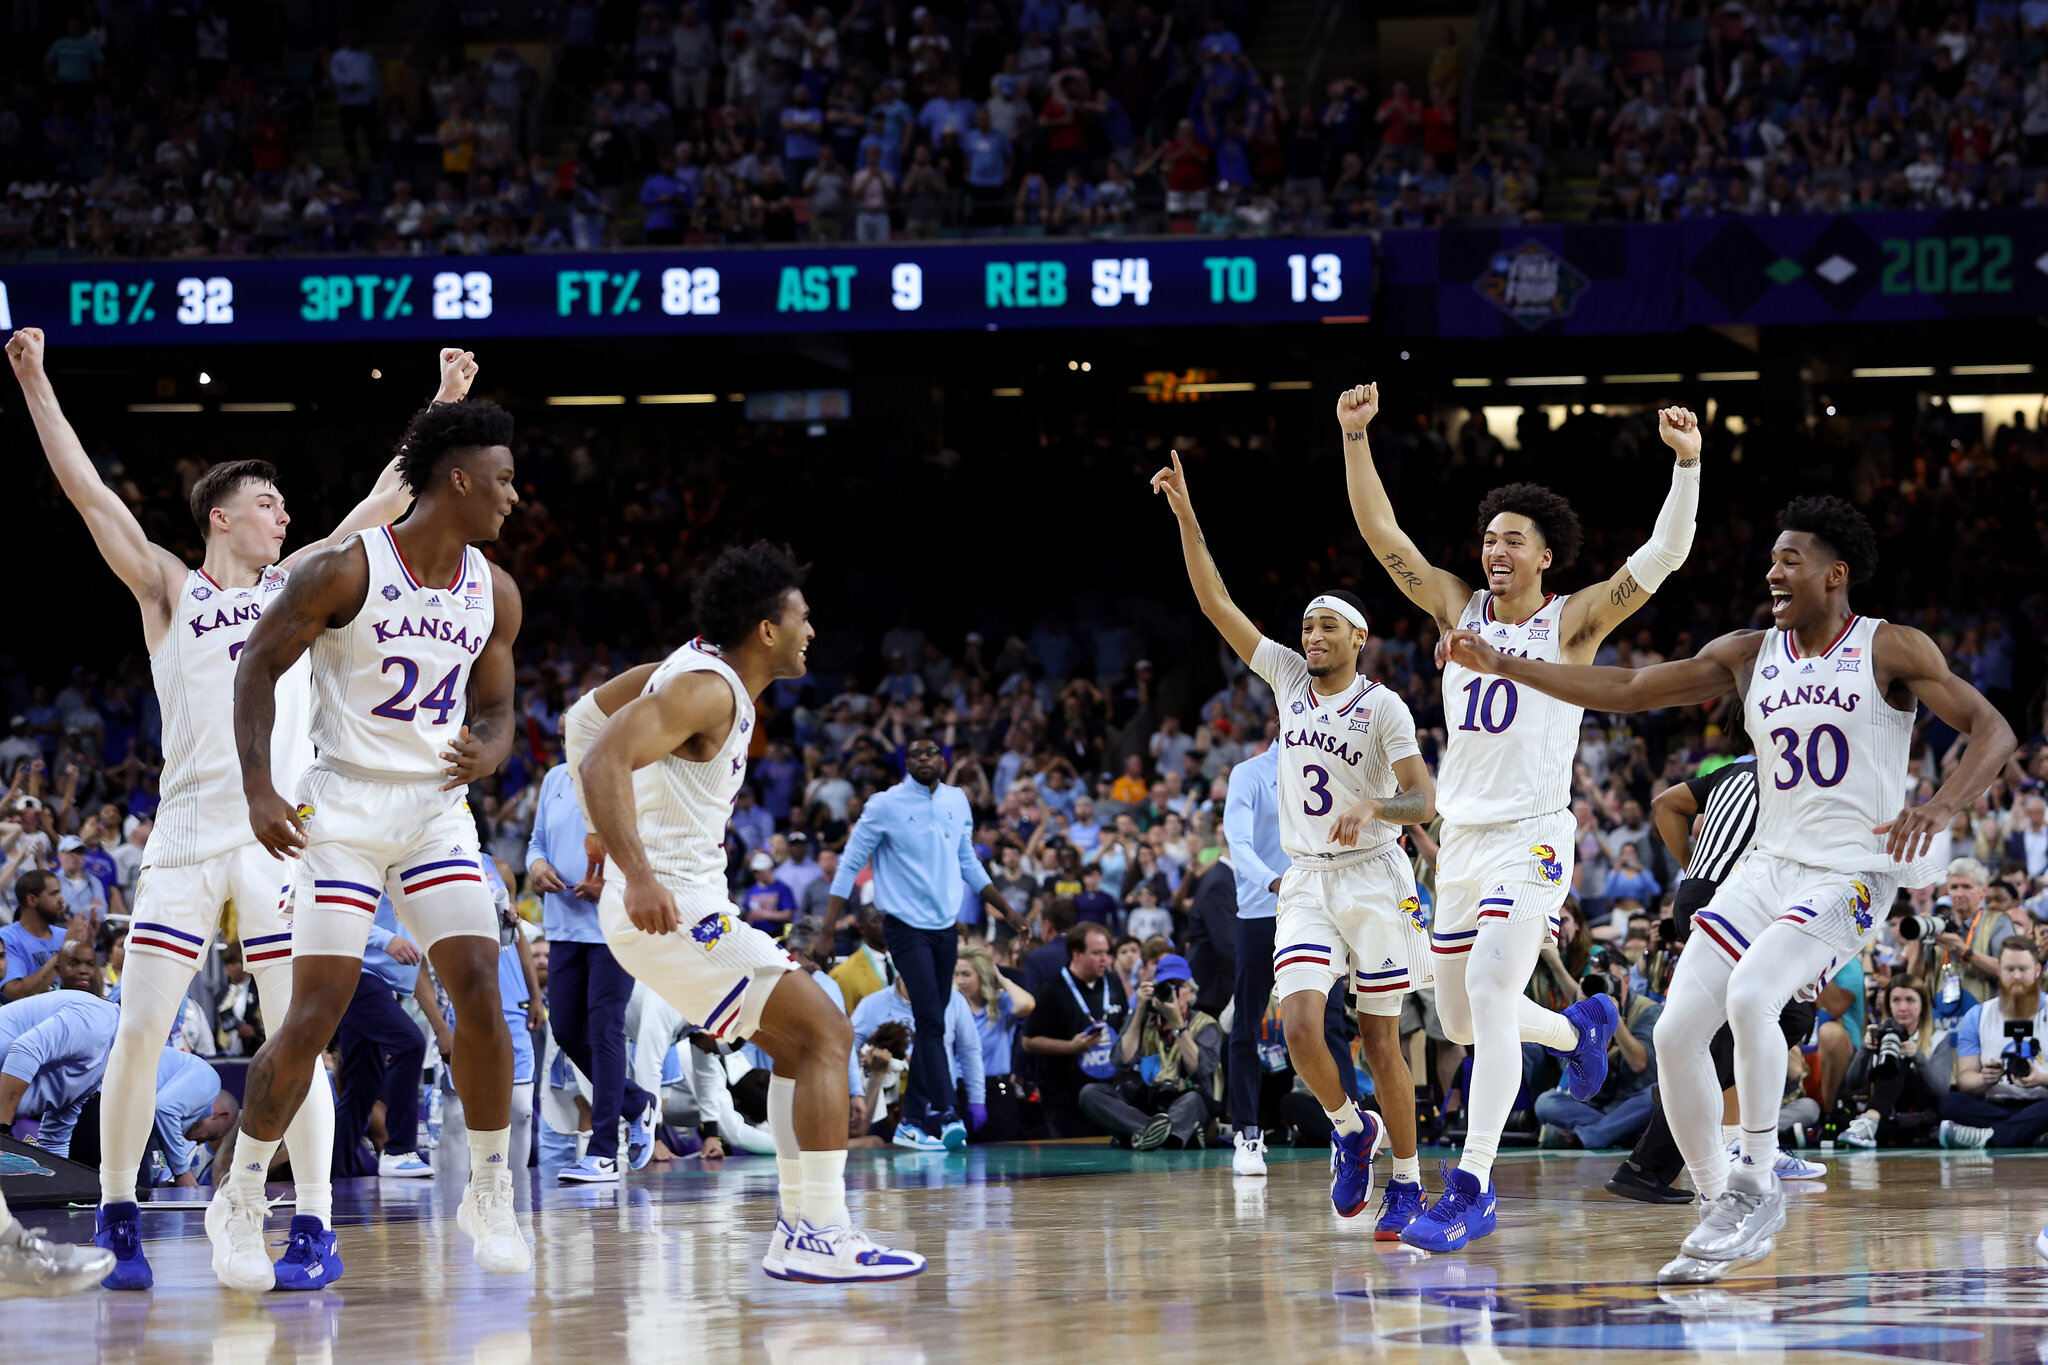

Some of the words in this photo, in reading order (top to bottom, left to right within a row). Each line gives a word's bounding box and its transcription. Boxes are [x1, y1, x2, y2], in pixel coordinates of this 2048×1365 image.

[176, 278, 234, 325] 32
[301, 275, 412, 321] 3PT%
[432, 272, 493, 320] 23
[558, 270, 641, 316] FT%
[661, 267, 721, 316] 82
[777, 265, 857, 312] AST
[891, 262, 923, 311] 9
[985, 261, 1067, 308] REB
[1091, 258, 1153, 307] 54
[1204, 257, 1257, 303] TO
[1287, 254, 1342, 303] 13
[1881, 236, 2013, 294] 2022
[1383, 552, 1423, 594] FEAR
[189, 602, 261, 639] KANS
[372, 616, 482, 655] KANSAS
[371, 657, 461, 726] 24
[1459, 676, 1518, 734] 10
[1758, 684, 1861, 719] KANSAS
[1284, 728, 1364, 766] KANSAS
[1770, 723, 1850, 790] 30
[1303, 764, 1334, 817] 3
